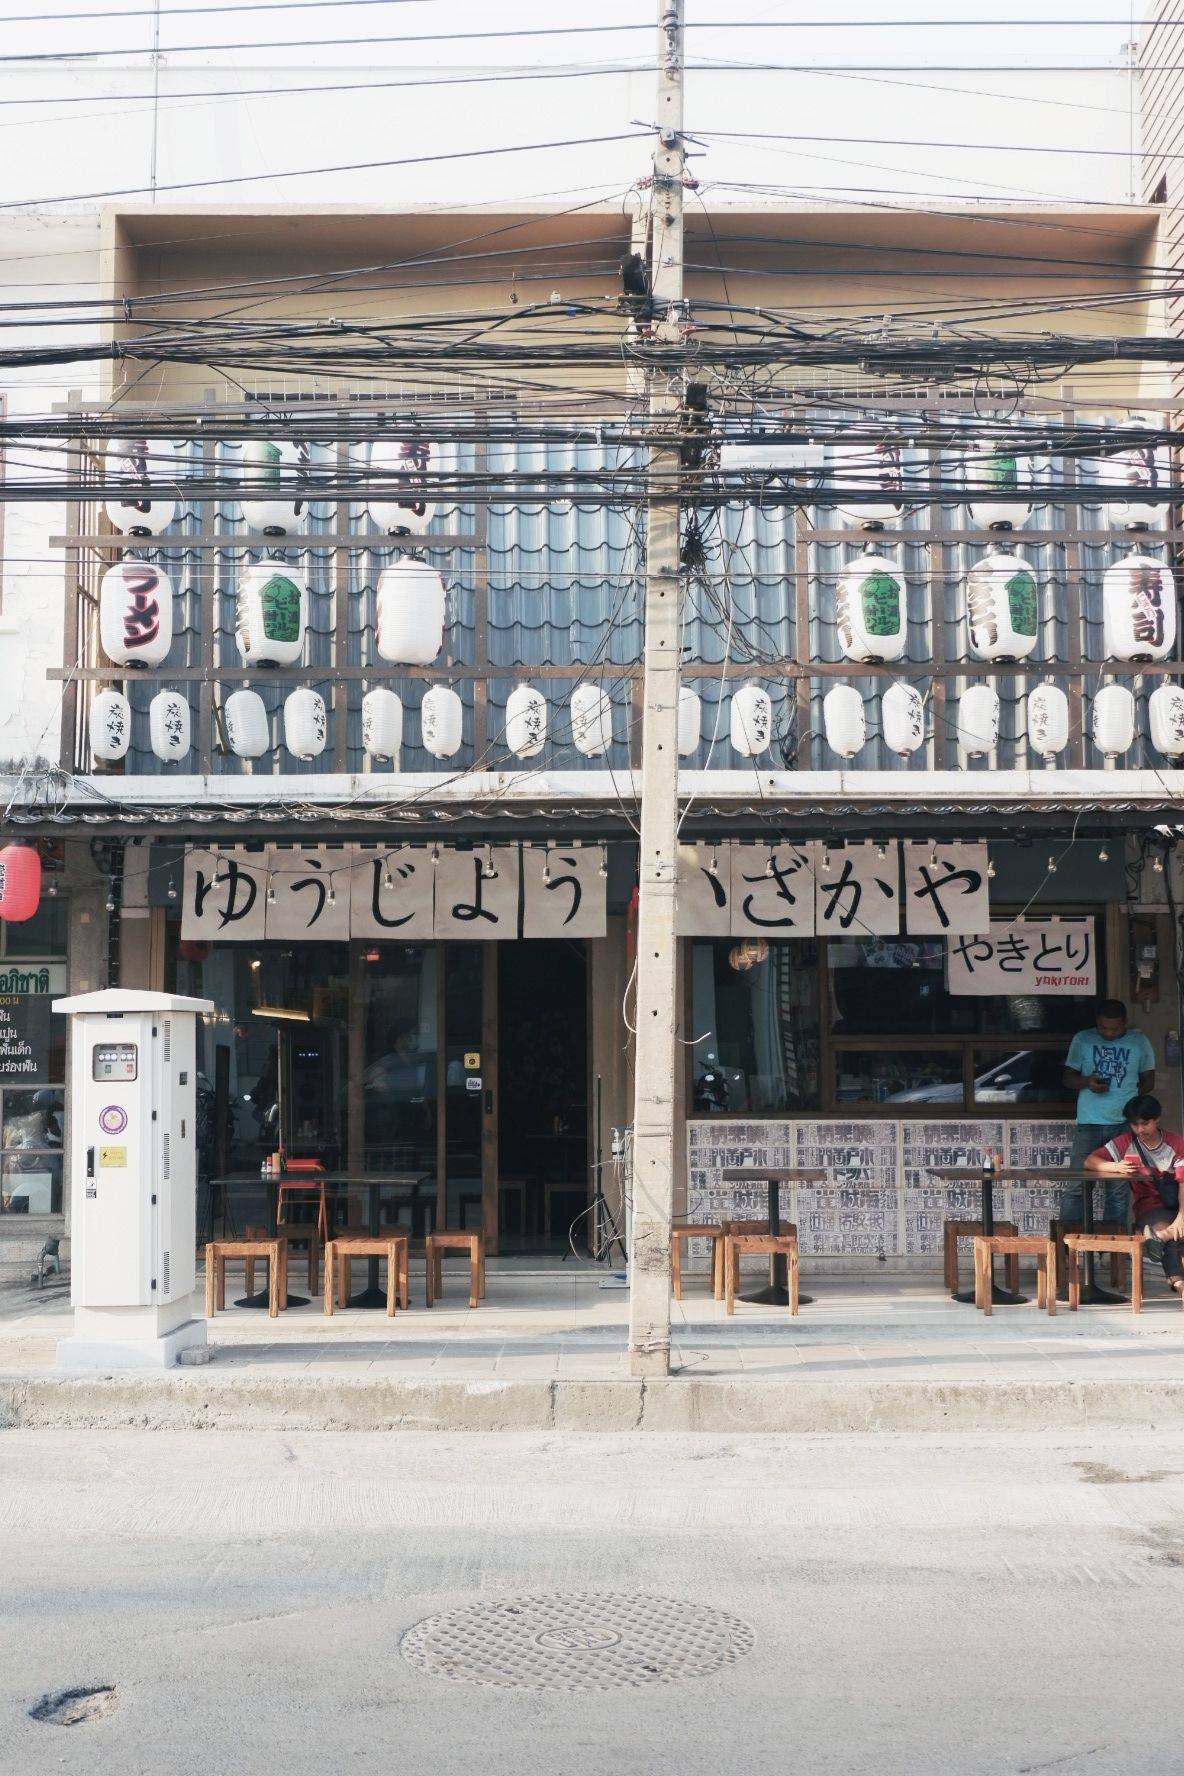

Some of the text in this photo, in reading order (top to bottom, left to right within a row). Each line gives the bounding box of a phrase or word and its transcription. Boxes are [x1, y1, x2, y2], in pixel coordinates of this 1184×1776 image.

[122, 566, 160, 650] ラーメン
[106, 704, 125, 749] 炭焼き
[164, 702, 185, 748] 炭焼き
[952, 932, 1091, 974] やきとり
[1034, 975, 1090, 987] YAKITORI
